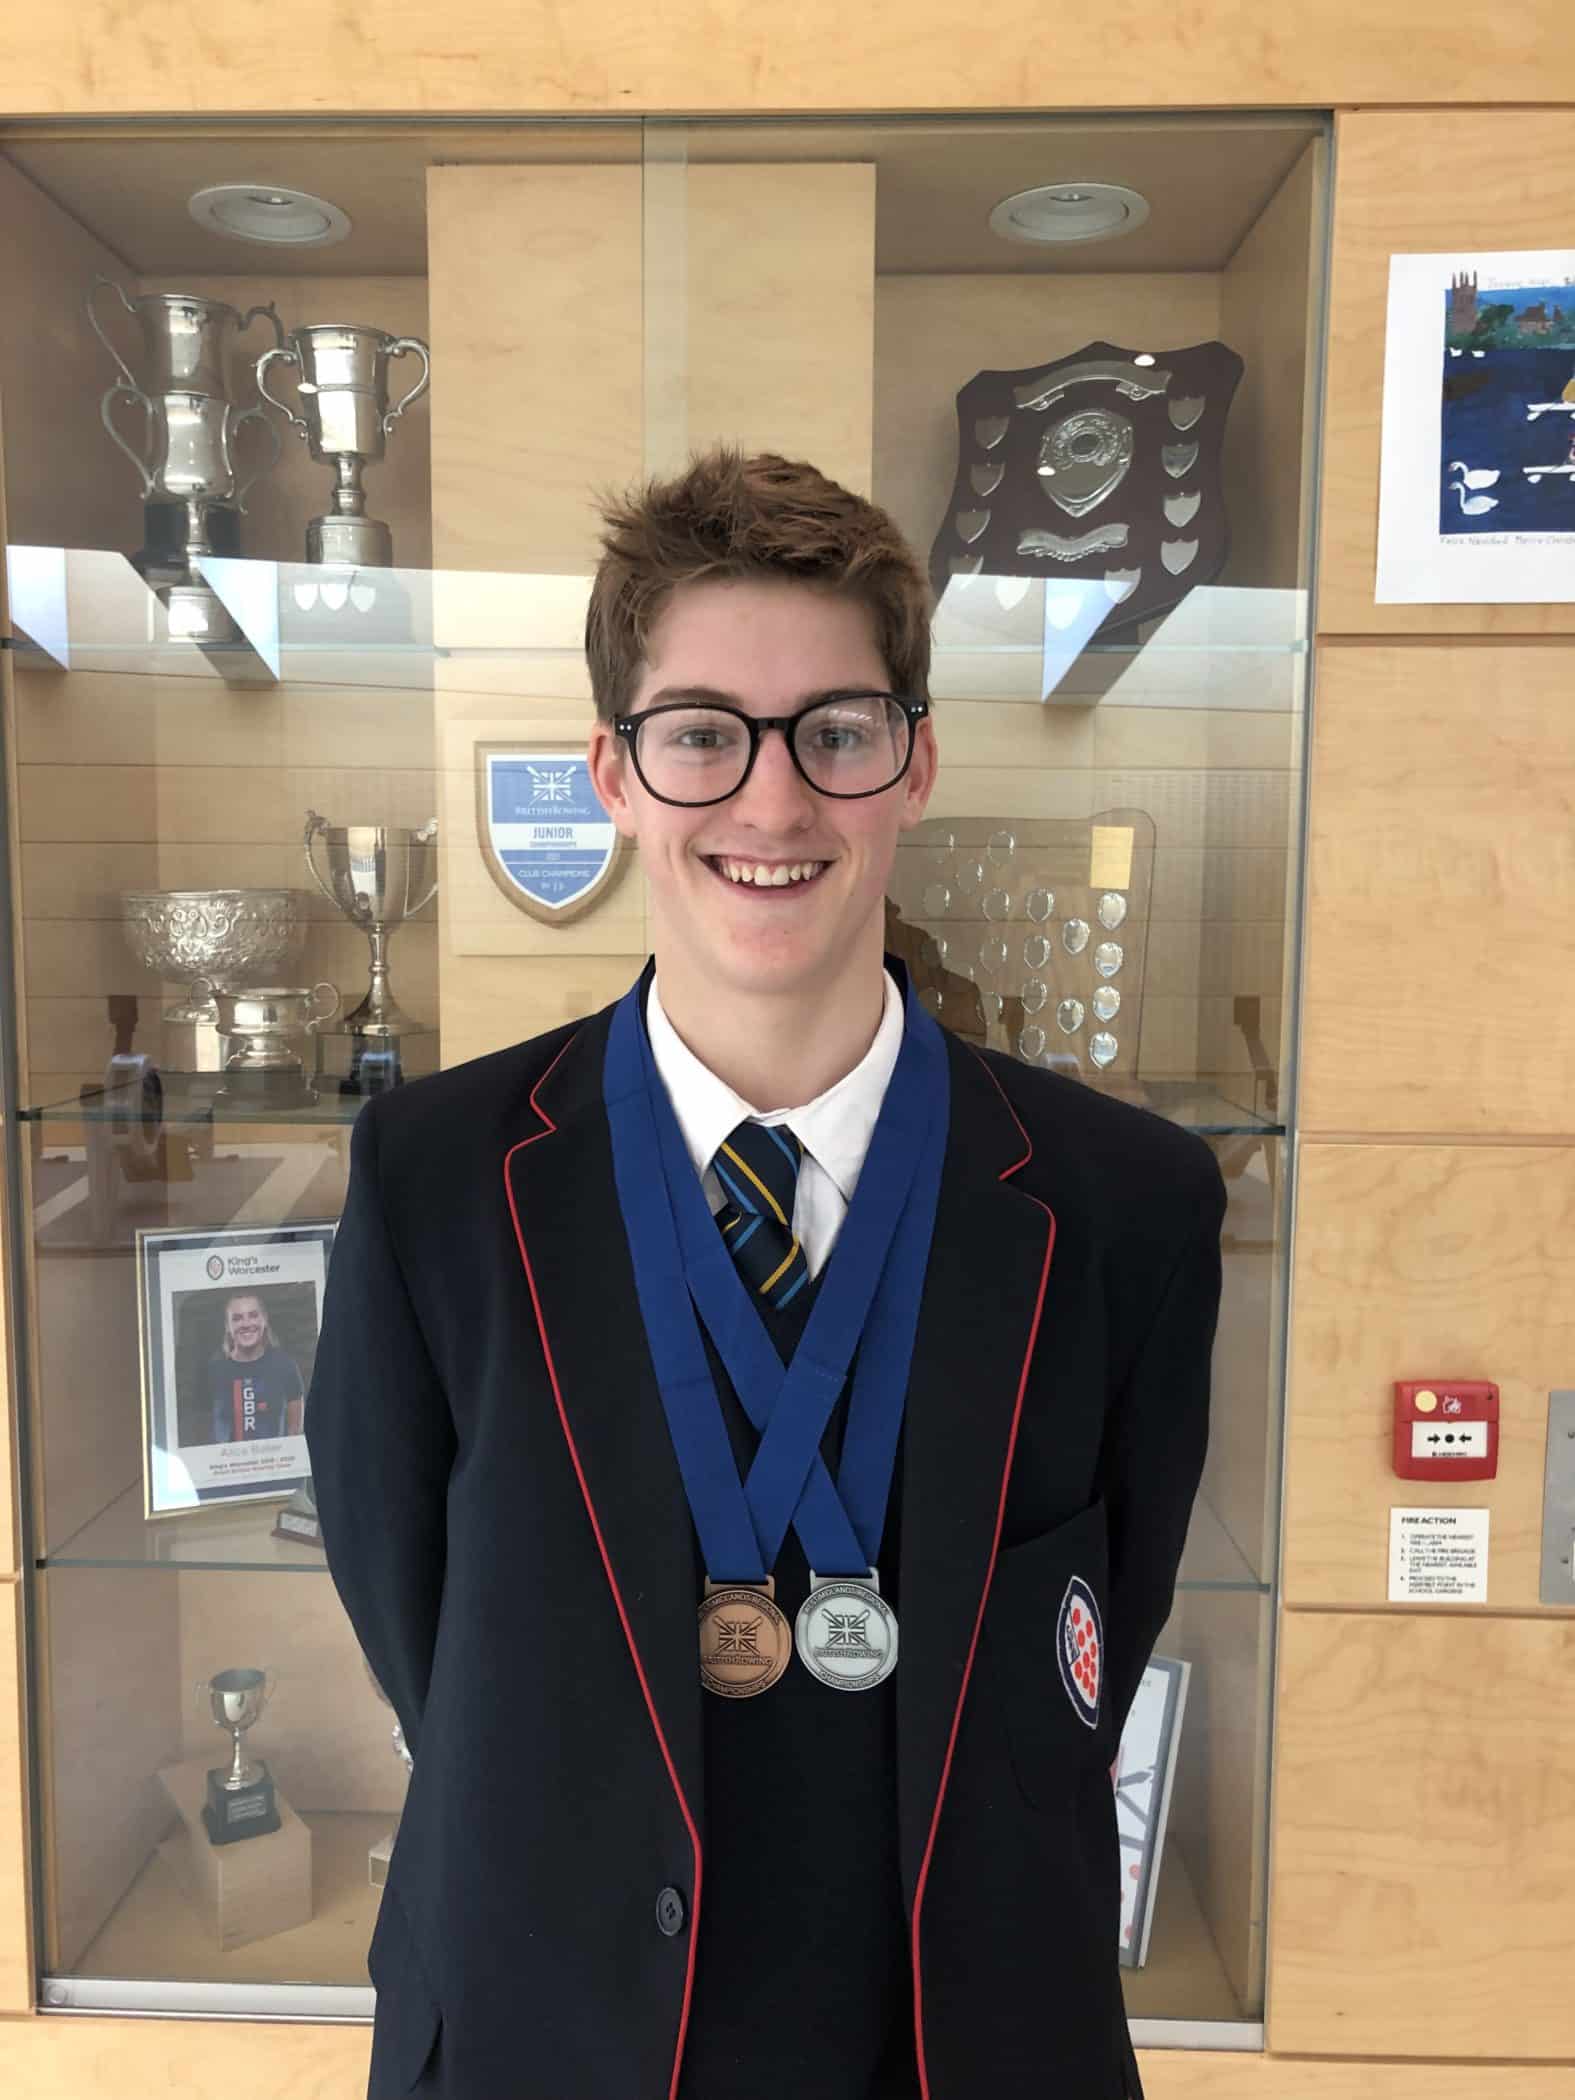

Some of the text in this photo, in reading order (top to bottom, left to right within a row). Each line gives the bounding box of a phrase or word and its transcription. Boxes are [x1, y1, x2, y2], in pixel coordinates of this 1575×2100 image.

[533, 826, 574, 840] JUNIOR
[227, 1256, 258, 1267] King's
[228, 1264, 281, 1276] Worcester
[243, 1386, 256, 1432] GBR
[1401, 1516, 1457, 1525] FIRE ACTION
